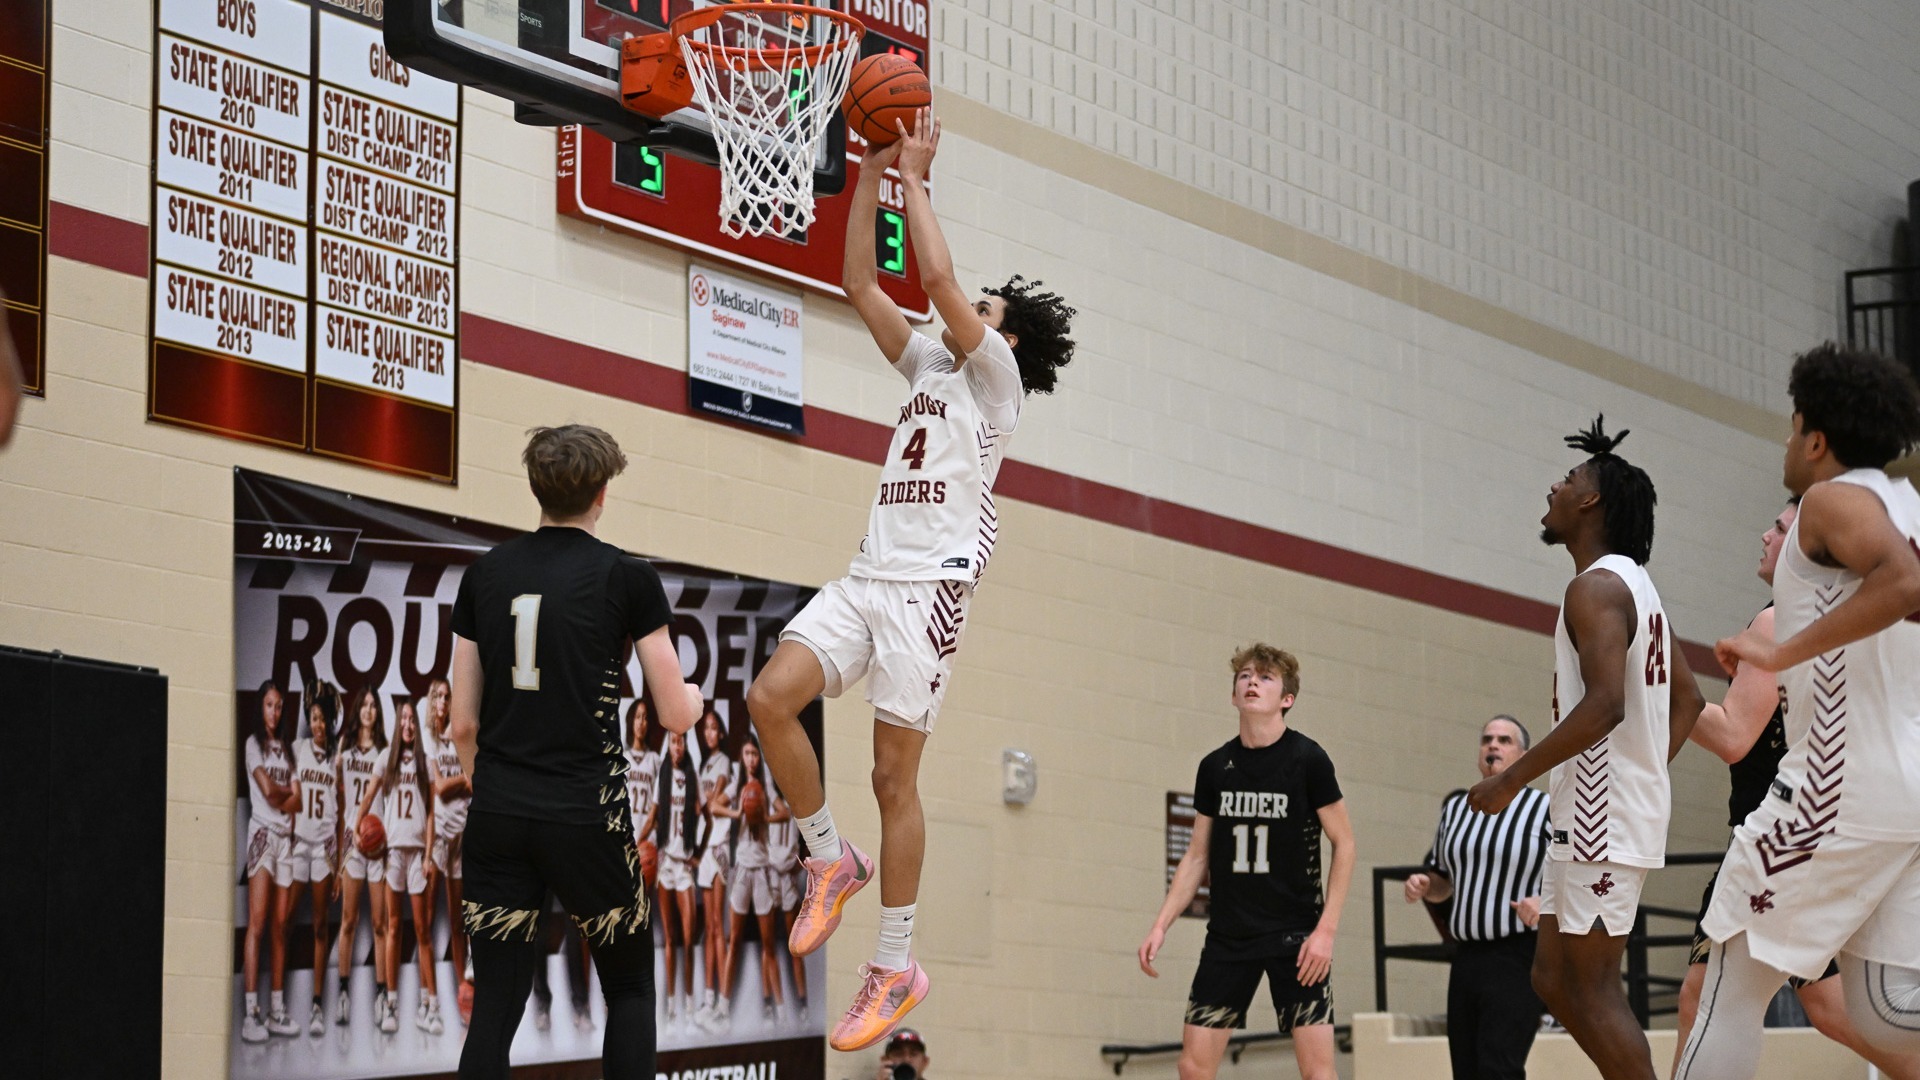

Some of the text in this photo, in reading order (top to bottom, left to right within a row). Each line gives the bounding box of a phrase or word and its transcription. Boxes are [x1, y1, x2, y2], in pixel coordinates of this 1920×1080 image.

[217, 0, 256, 38] BOYS
[520, 12, 543, 28] SPORTS
[170, 43, 299, 117] STATE QUALIFIER
[220, 98, 255, 129] 2010
[323, 90, 451, 163] STATE QUALIFIER
[169, 118, 297, 190] STATE QUALIFIER
[327, 130, 446, 186] DIST CHAMP 2011
[558, 124, 578, 178] fair-p
[219, 173, 252, 202] 2011
[326, 166, 446, 233] STATE QUALIFIER
[879, 177, 905, 209] ULS
[168, 195, 296, 265] STATE QUALIFIER
[324, 202, 448, 258] DIST CHAMP 2012
[884, 212, 904, 271] 3
[218, 250, 253, 279] 2012
[321, 239, 450, 306] REGIONAL CHAMPS
[167, 273, 296, 340] STATE QUALIFIER
[328, 278, 448, 329] DIST CHAMP 2013
[712, 286, 758, 317] Medical
[712, 309, 746, 329] Saginaw
[217, 325, 251, 354] 2013
[327, 313, 444, 376] STATE QUALIFIER
[372, 363, 404, 390] 2013
[901, 428, 926, 470] 4
[878, 480, 946, 505] RIDERS
[262, 532, 332, 553] 2023-24
[272, 595, 453, 700] ROU
[511, 593, 542, 691] 1
[1645, 613, 1666, 686] 24
[308, 789, 324, 819] 15
[398, 790, 412, 819] 12
[1219, 791, 1288, 818] RIDER
[1232, 825, 1270, 874] 11
